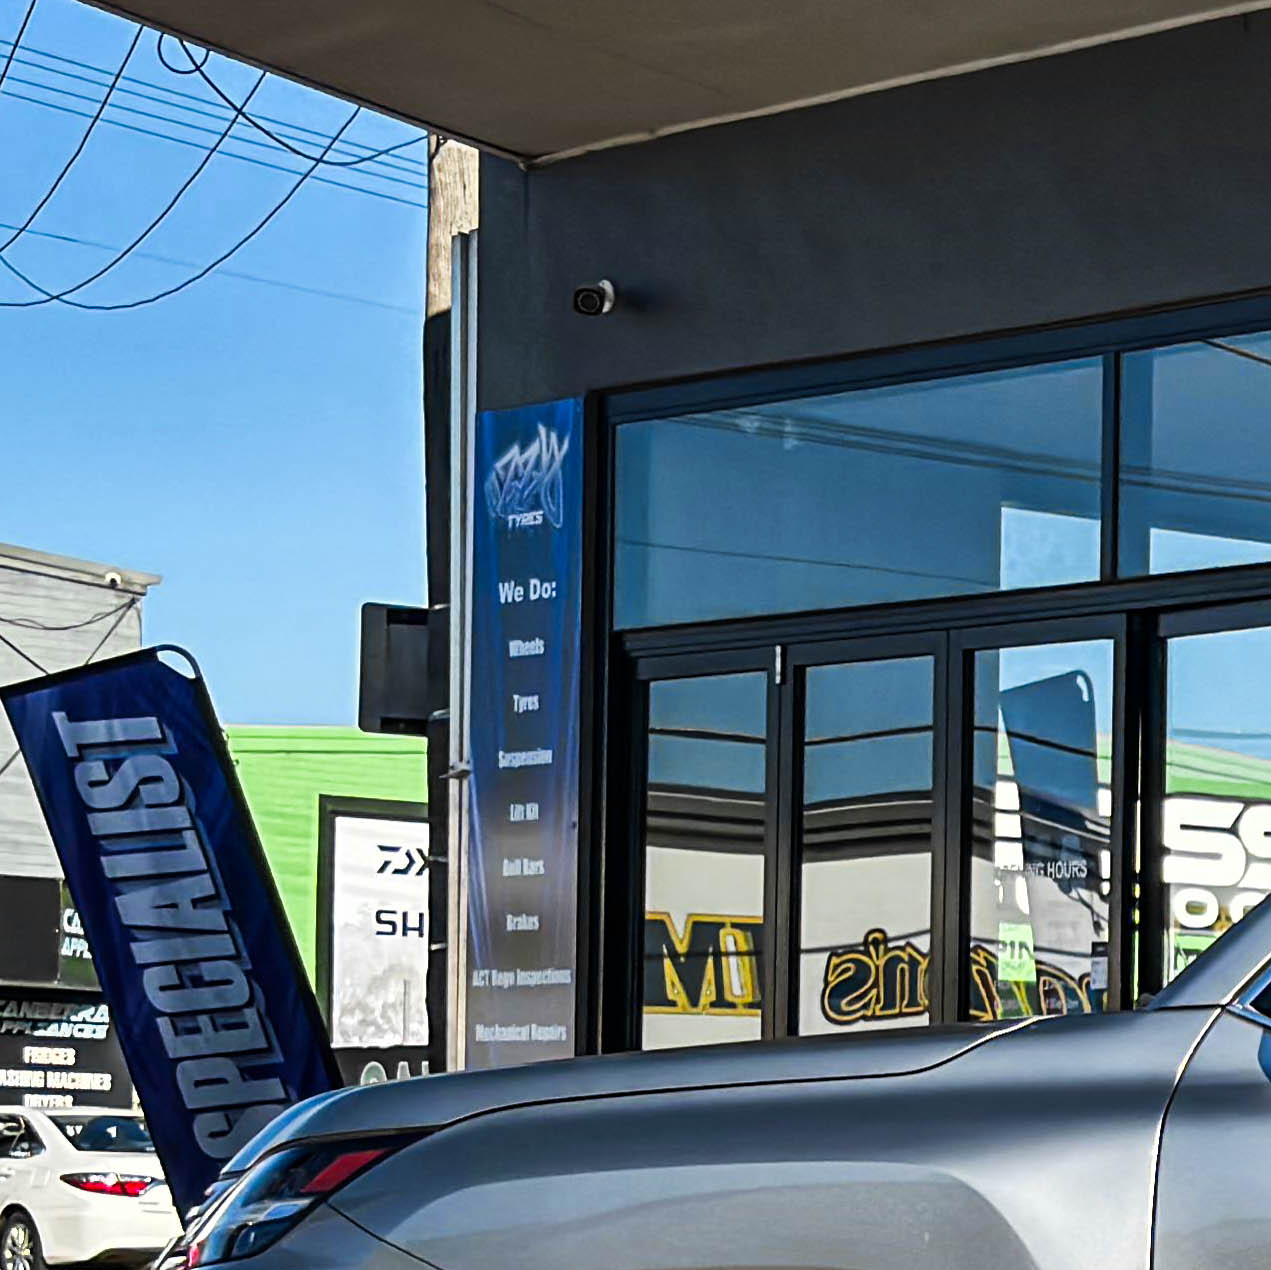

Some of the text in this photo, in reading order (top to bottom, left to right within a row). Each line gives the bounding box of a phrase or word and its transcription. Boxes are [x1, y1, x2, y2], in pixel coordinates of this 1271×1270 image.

[499, 577, 557, 604] We Do:
[509, 636, 545, 658] Wheels
[513, 694, 540, 713] Tyres
[498, 749, 553, 769] Suspension
[1047, 859, 1088, 879] HOURS
[375, 909, 424, 938] SH
[506, 913, 540, 931] Brakes
[53, 711, 290, 1160] SPECIALIST
[473, 969, 490, 987] ACT
[516, 967, 571, 987] Inspections
[0, 1000, 110, 1023] ANBERRA
[0, 1021, 109, 1039] PPLIANCES
[475, 1024, 567, 1042] Mechanical Repairs
[0, 1069, 112, 1091] ASHING MACHINES
